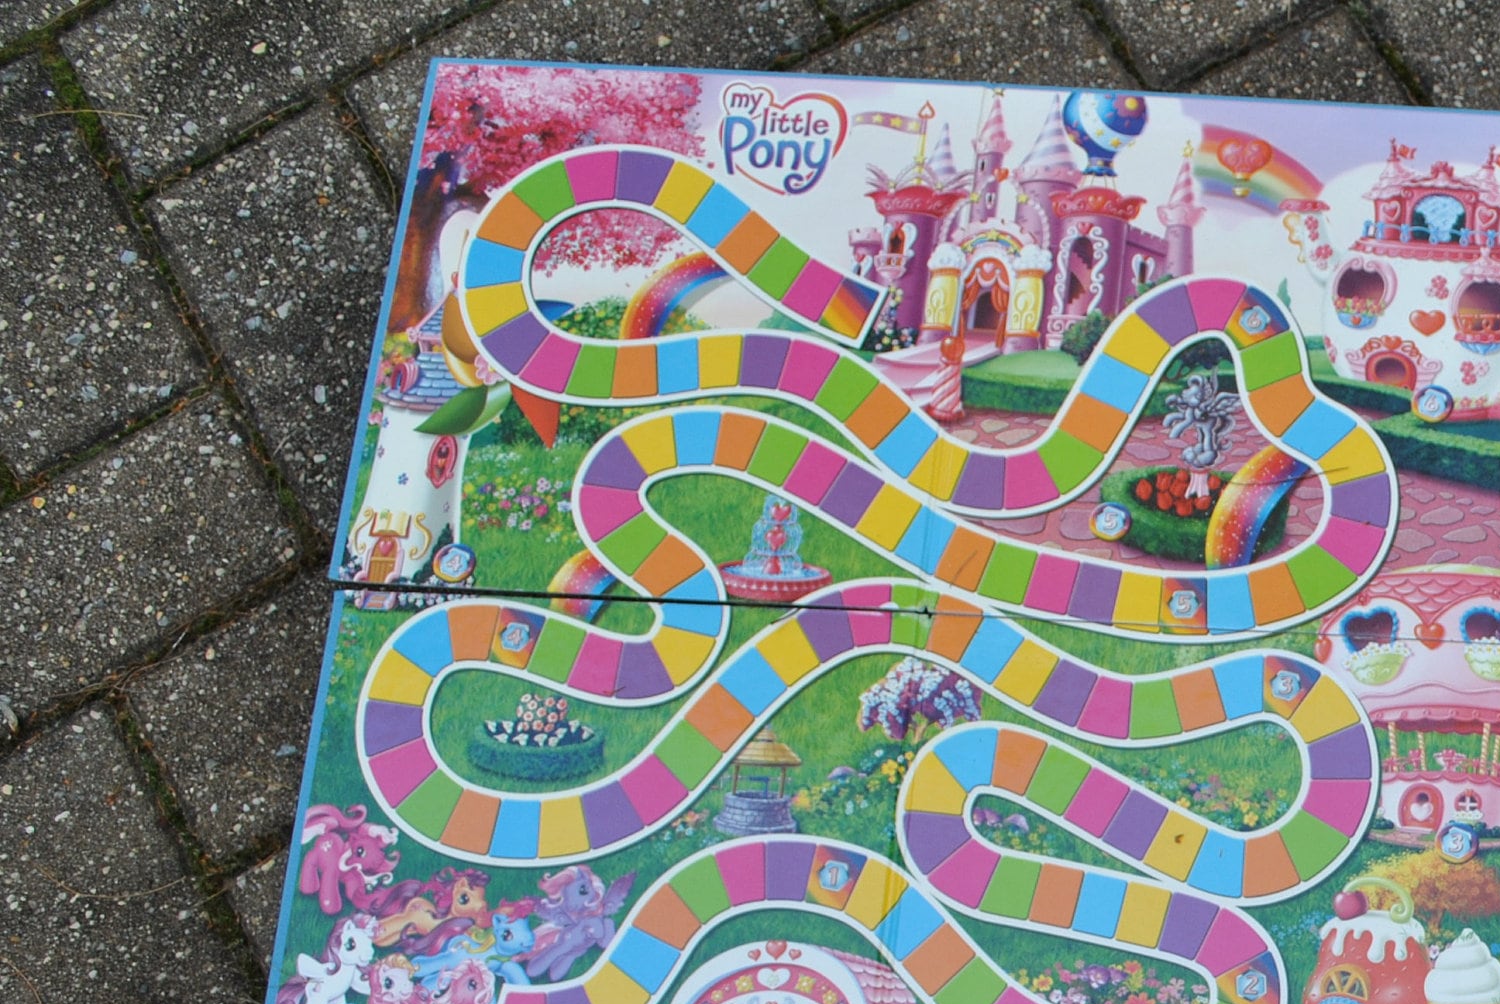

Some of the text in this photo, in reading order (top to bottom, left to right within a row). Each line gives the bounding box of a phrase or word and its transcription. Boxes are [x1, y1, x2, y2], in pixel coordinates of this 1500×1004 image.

[730, 92, 764, 115] my
[760, 107, 830, 137] little
[723, 116, 833, 195] Pony
[1247, 308, 1261, 328] 6
[1424, 393, 1439, 413] 6
[1103, 511, 1119, 531] 5
[447, 554, 462, 572] 4
[1177, 594, 1191, 613] 5
[507, 628, 523, 645] 4
[1280, 676, 1294, 695] 3
[1450, 832, 1464, 852] 3
[829, 866, 839, 887] 1
[1243, 975, 1259, 995] 2
